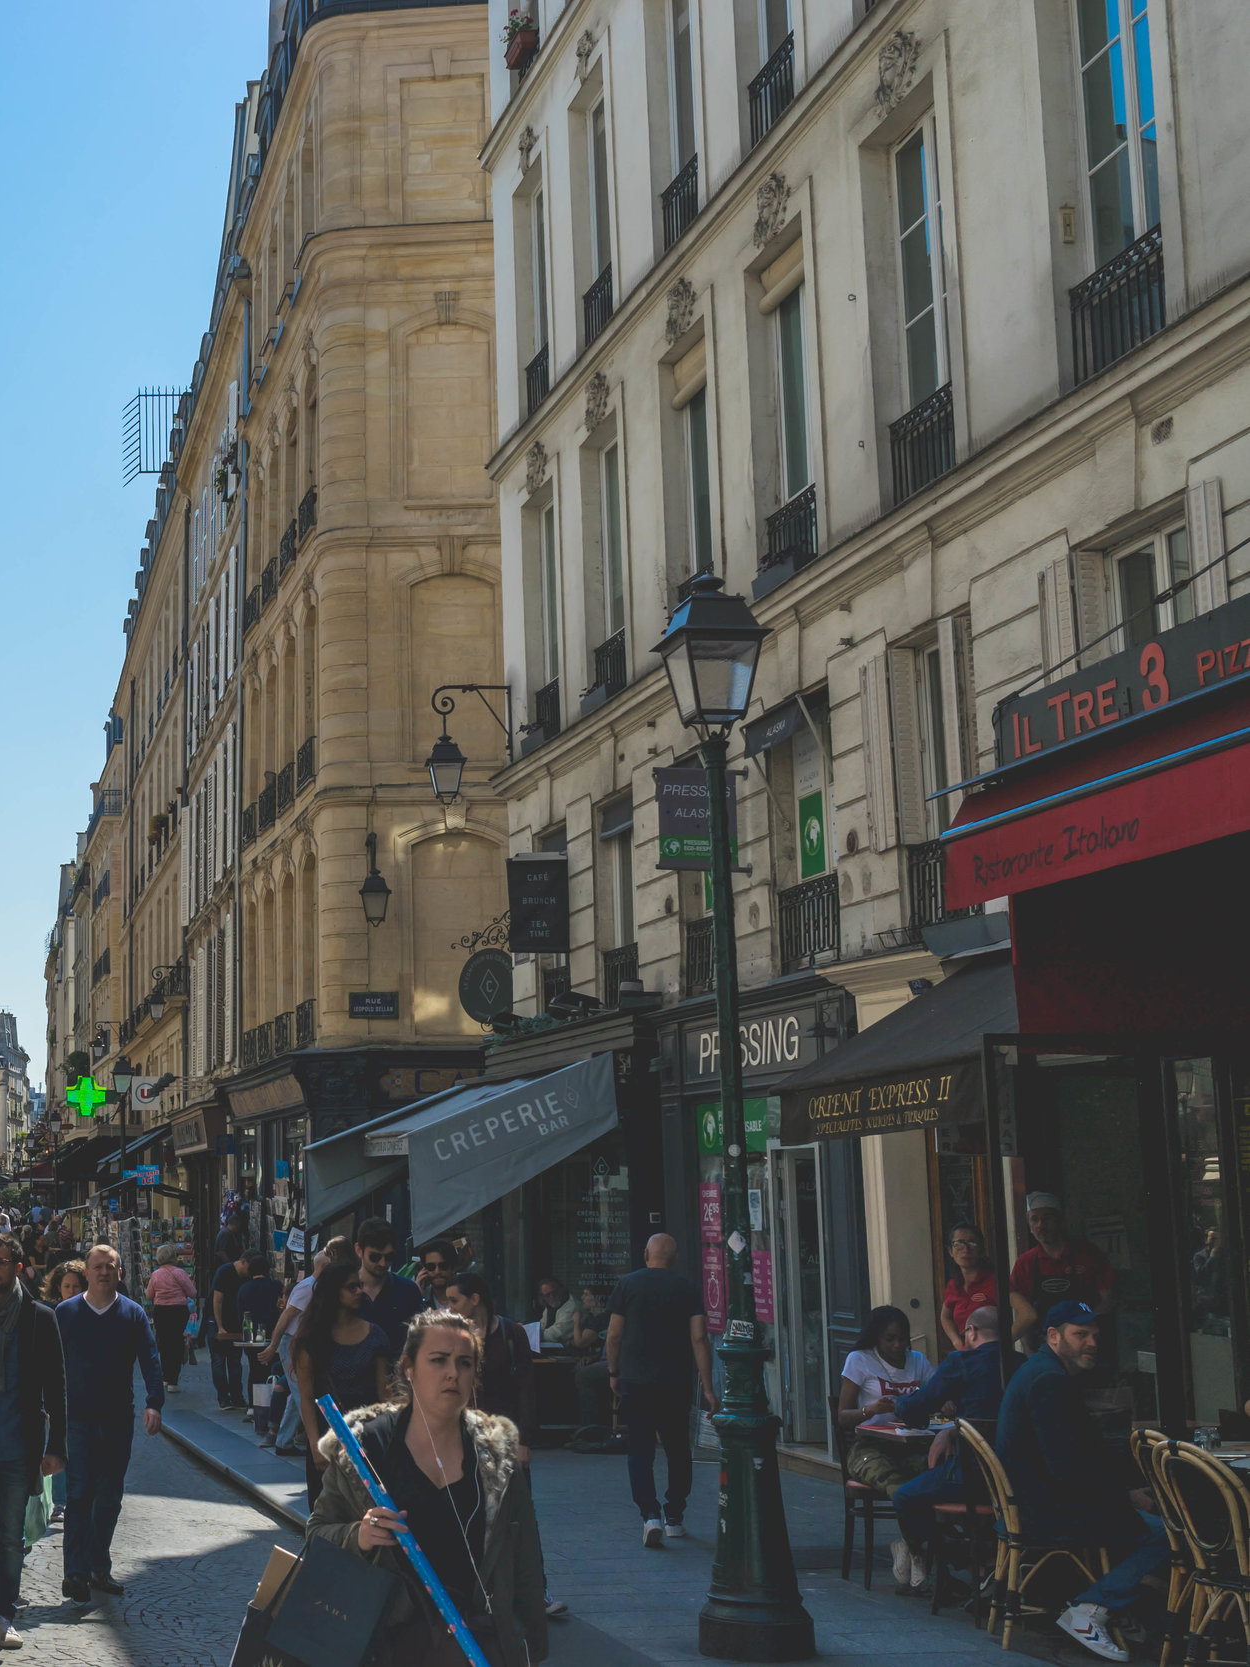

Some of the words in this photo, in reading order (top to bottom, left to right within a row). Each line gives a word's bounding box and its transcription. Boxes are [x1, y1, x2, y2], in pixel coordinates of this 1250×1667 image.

[1012, 712, 1042, 759] IL
[1047, 678, 1121, 742] TRE
[1140, 642, 1170, 712] 3
[973, 840, 1054, 886] Ristorante
[1062, 816, 1140, 861] Italiano
[526, 872, 549, 882] CAFÉ
[522, 897, 556, 905] BRUNCH
[529, 930, 550, 938] TIME
[698, 1016, 800, 1075] PRSSING
[808, 1086, 864, 1119] ORIENT
[868, 1079, 931, 1111] EXPRESS
[937, 1075, 952, 1100] II
[434, 1091, 563, 1161] CRÊPERIE
[538, 1115, 569, 1136] BAR
